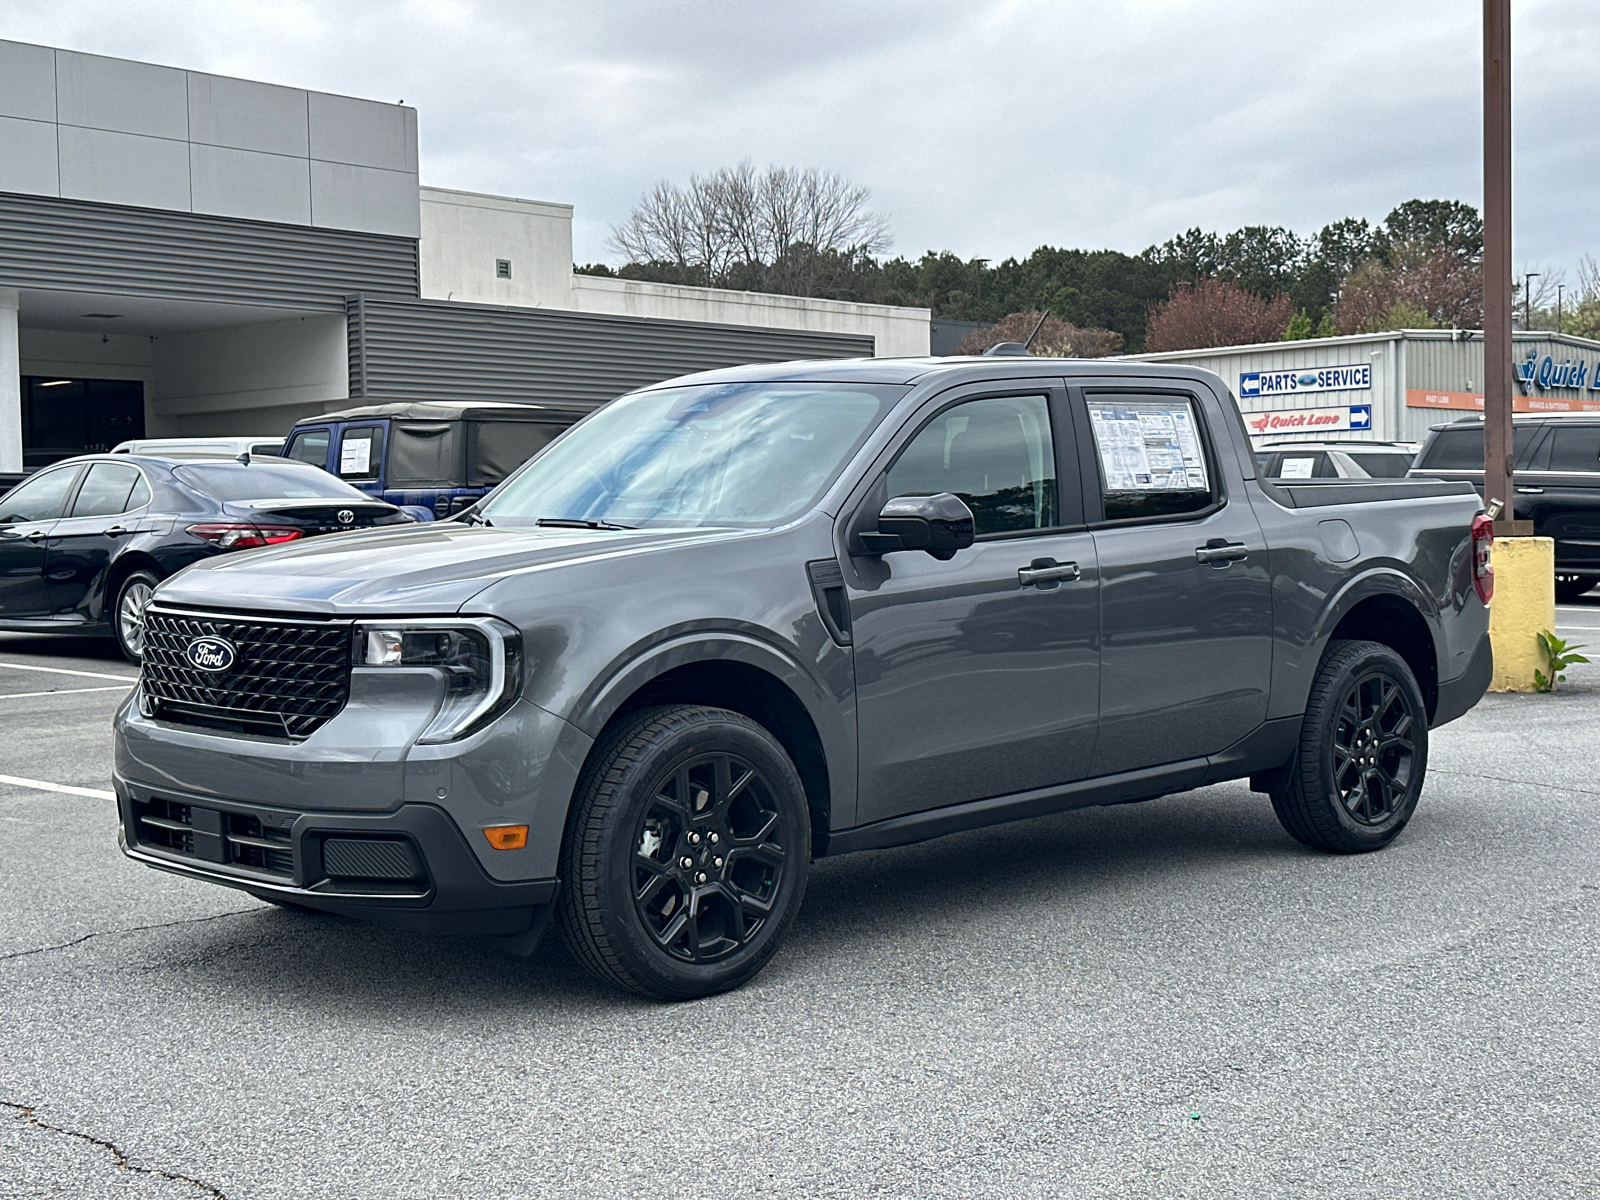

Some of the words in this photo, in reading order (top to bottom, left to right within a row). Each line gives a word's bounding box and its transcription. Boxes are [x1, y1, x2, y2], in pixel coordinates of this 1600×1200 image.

[1261, 374, 1297, 392] PARTS
[1318, 368, 1369, 388] SERVICE
[1539, 355, 1588, 389] Quick
[1426, 394, 1437, 404] FAST
[1270, 414, 1306, 428] Quick
[1307, 414, 1340, 425] Lane
[195, 642, 225, 668] Ford
